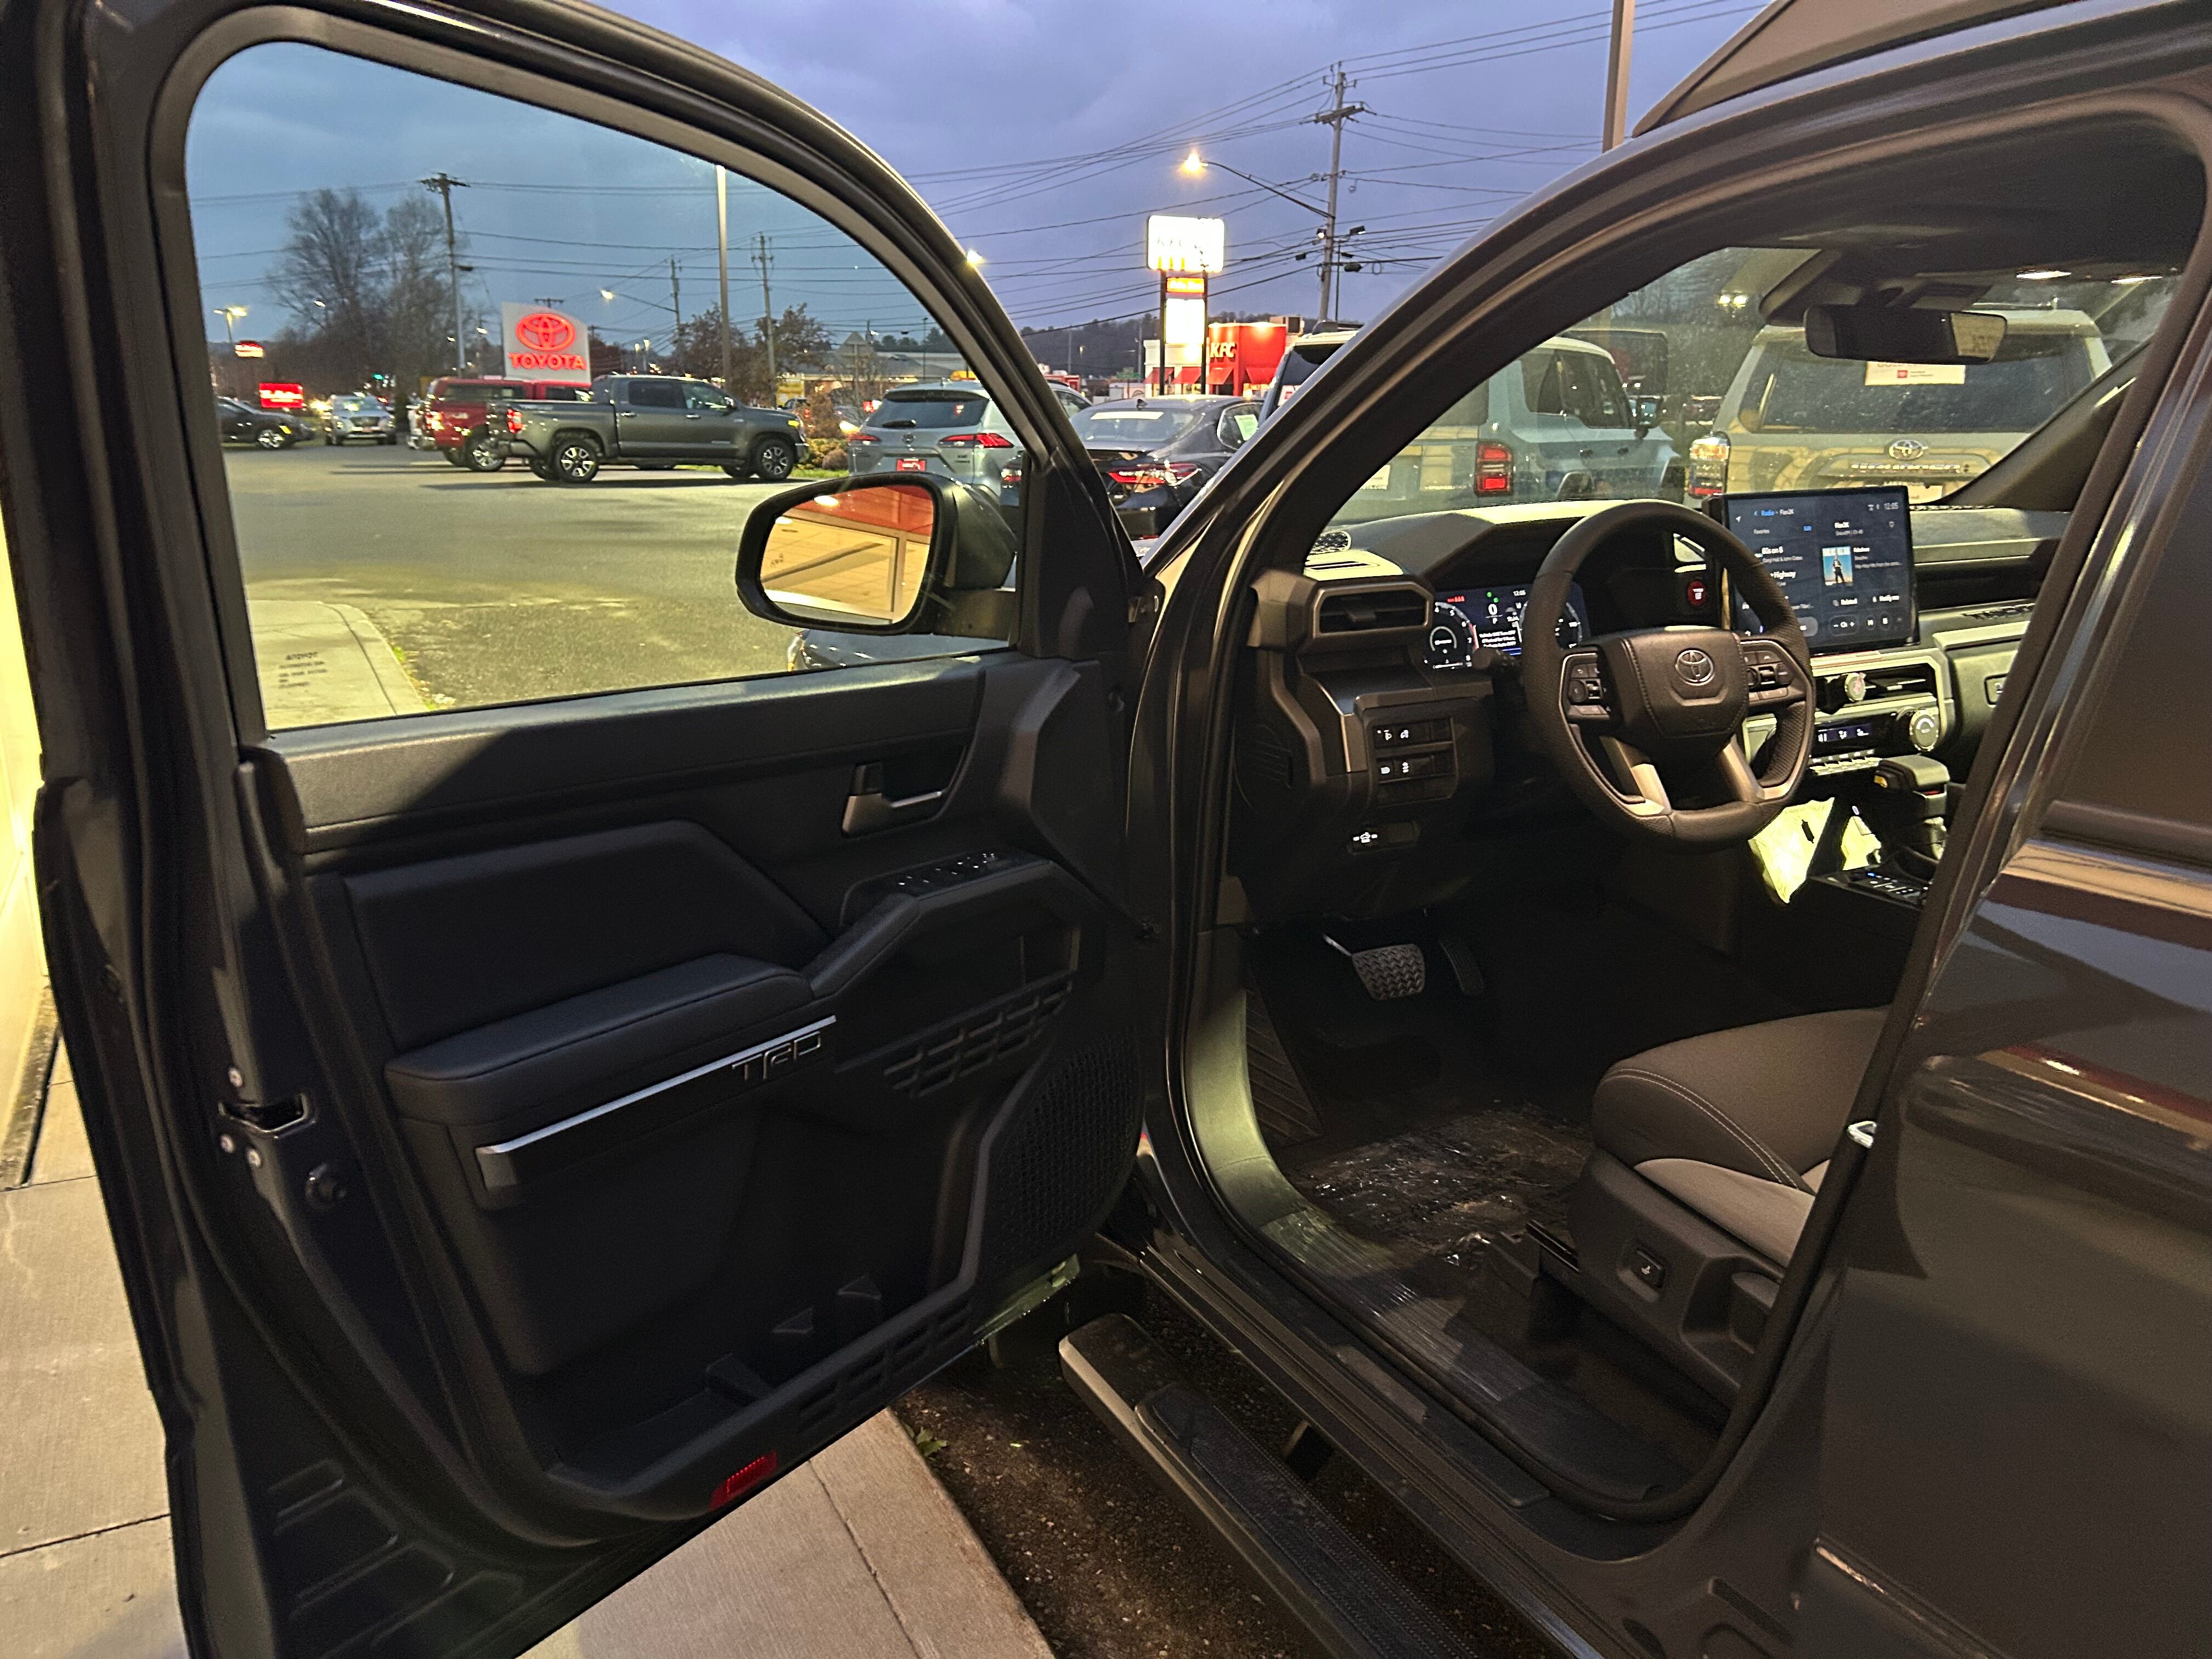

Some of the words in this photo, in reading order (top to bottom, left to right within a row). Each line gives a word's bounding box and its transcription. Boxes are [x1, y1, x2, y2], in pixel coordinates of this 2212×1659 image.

[1210, 342, 1237, 360] KFC
[507, 353, 588, 370] TOYOTA
[1488, 603, 1498, 615] 0
[732, 1030, 821, 1081] TRD
